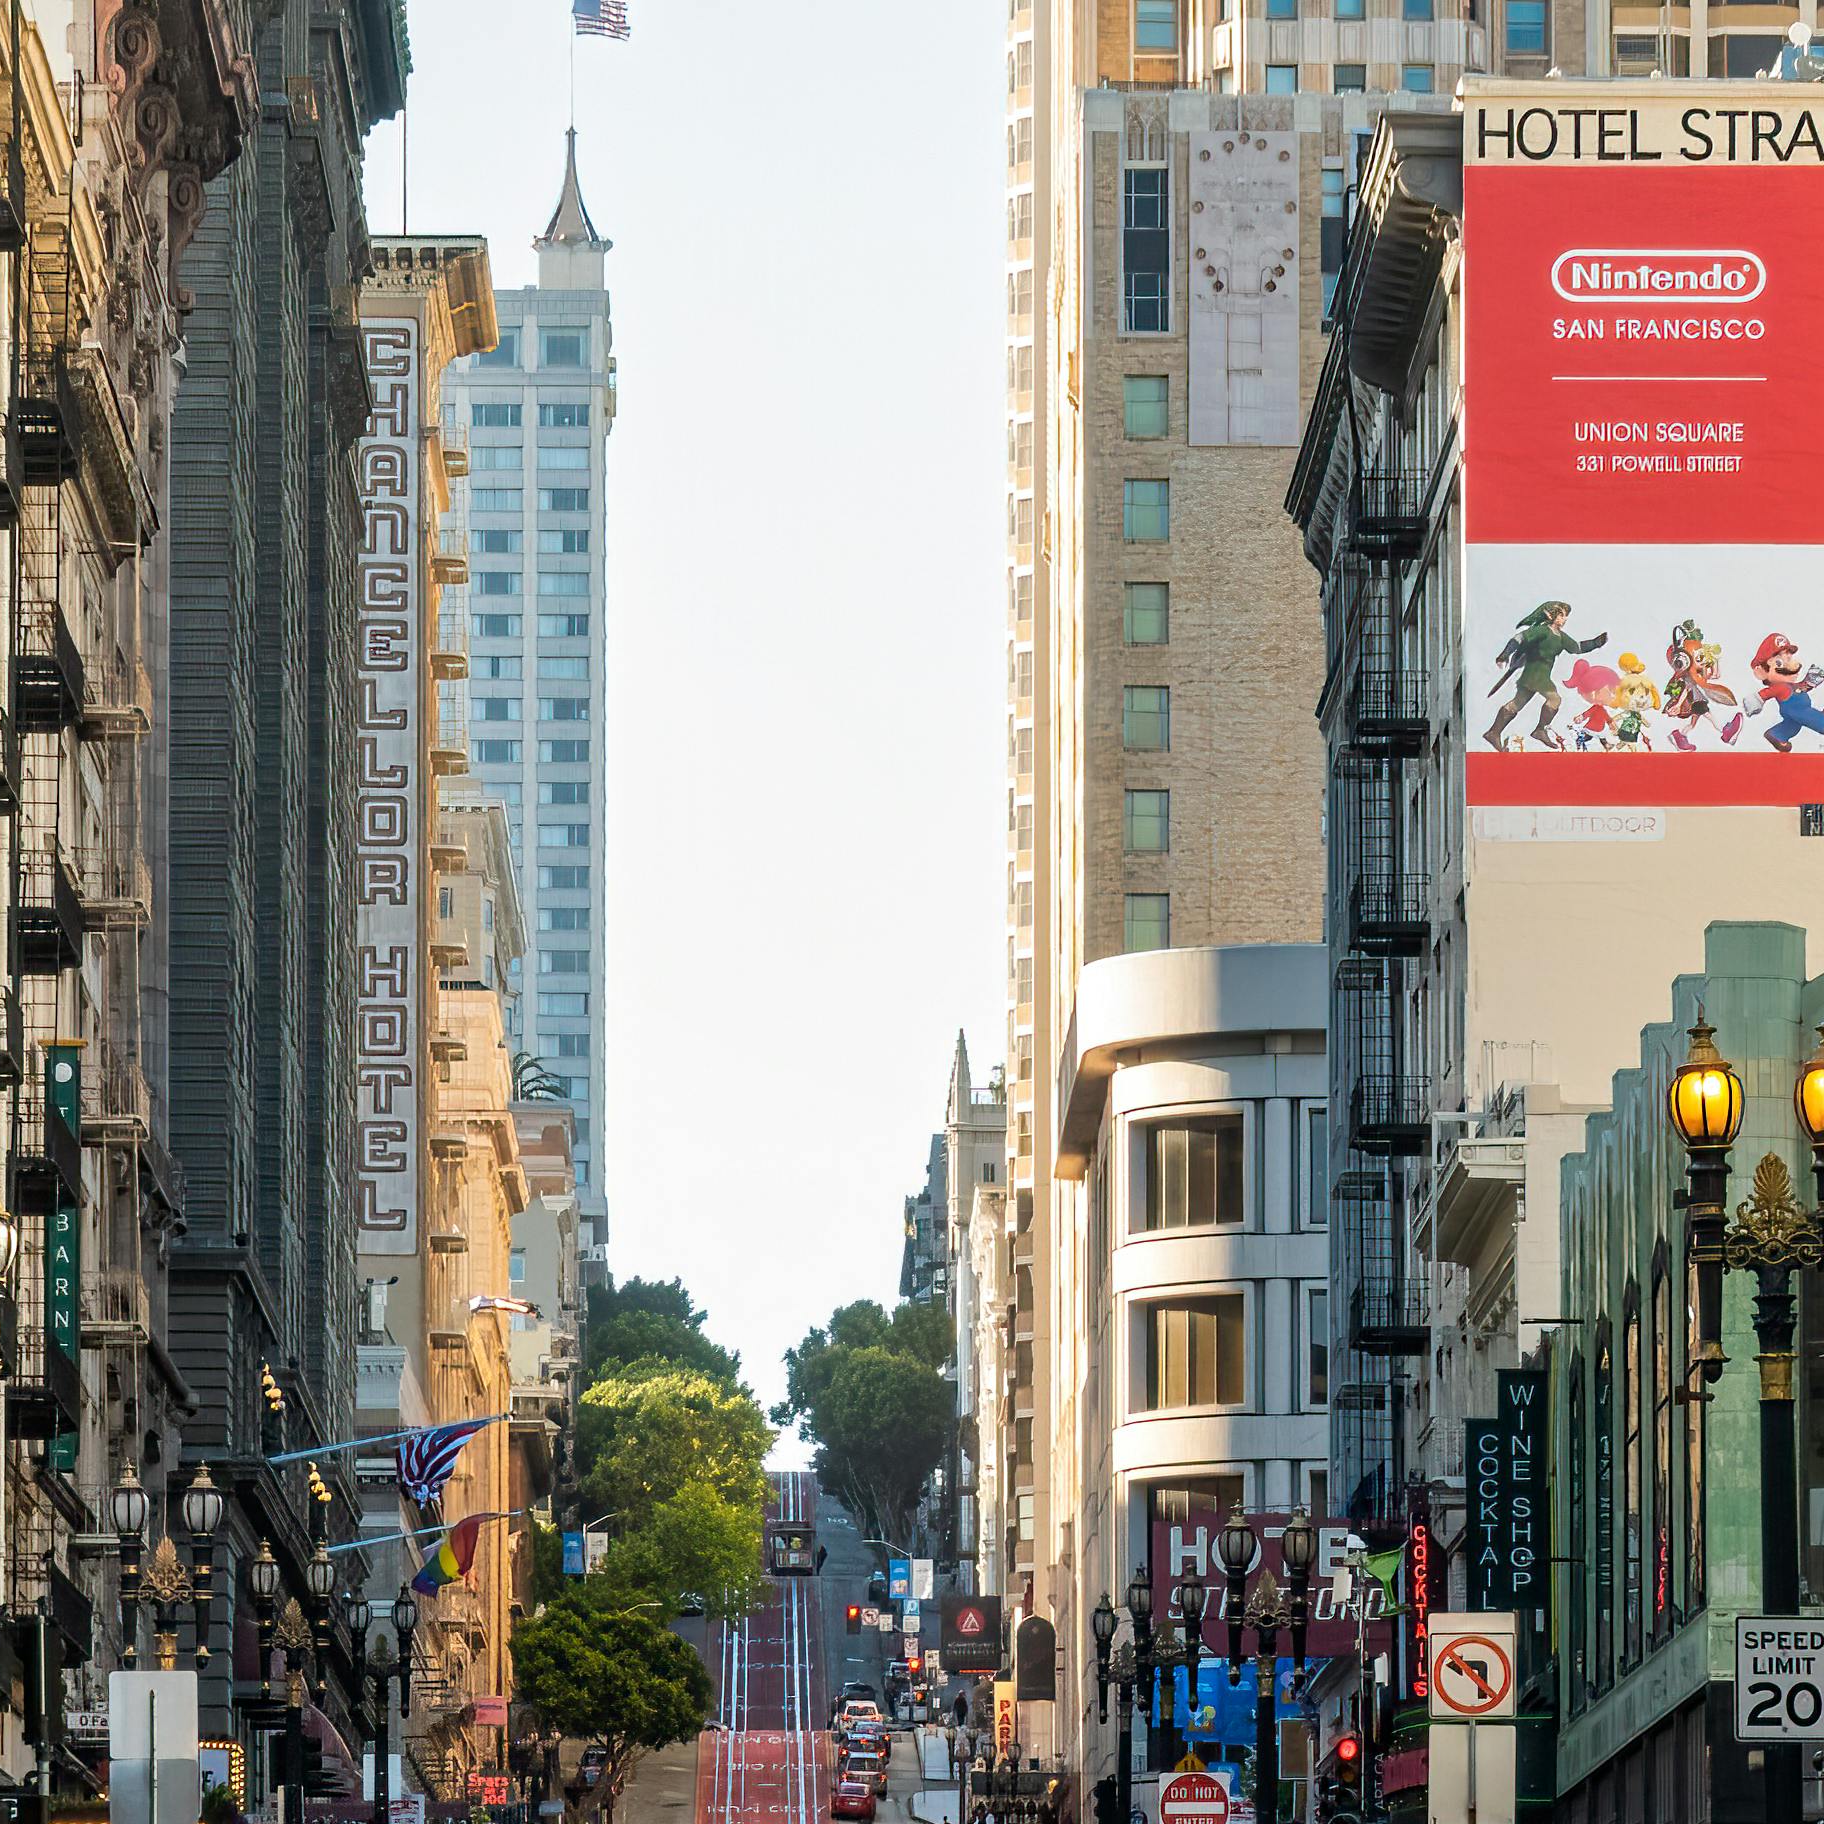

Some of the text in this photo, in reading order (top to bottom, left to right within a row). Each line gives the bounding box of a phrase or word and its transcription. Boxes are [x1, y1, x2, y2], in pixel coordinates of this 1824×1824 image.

[1478, 109, 1662, 161] HOTEL
[1572, 263, 1746, 290] Nintendo
[1553, 319, 1765, 339] SAN FRANCISCO
[1575, 422, 1744, 442] UNION SQUARE
[1612, 455, 1682, 472] POWELL
[1687, 455, 1742, 472] STREET
[358, 327, 413, 1231] CHANCELLOR HOTEL
[1509, 1384, 1535, 1592] WINE SHOP
[1479, 1434, 1499, 1610] COCKTAIL
[1414, 1525, 1428, 1697] COCKTAILS
[1752, 1656, 1816, 1676] LIMIT
[1746, 1681, 1823, 1728] 20
[1170, 1786, 1219, 1799] DO NOT
